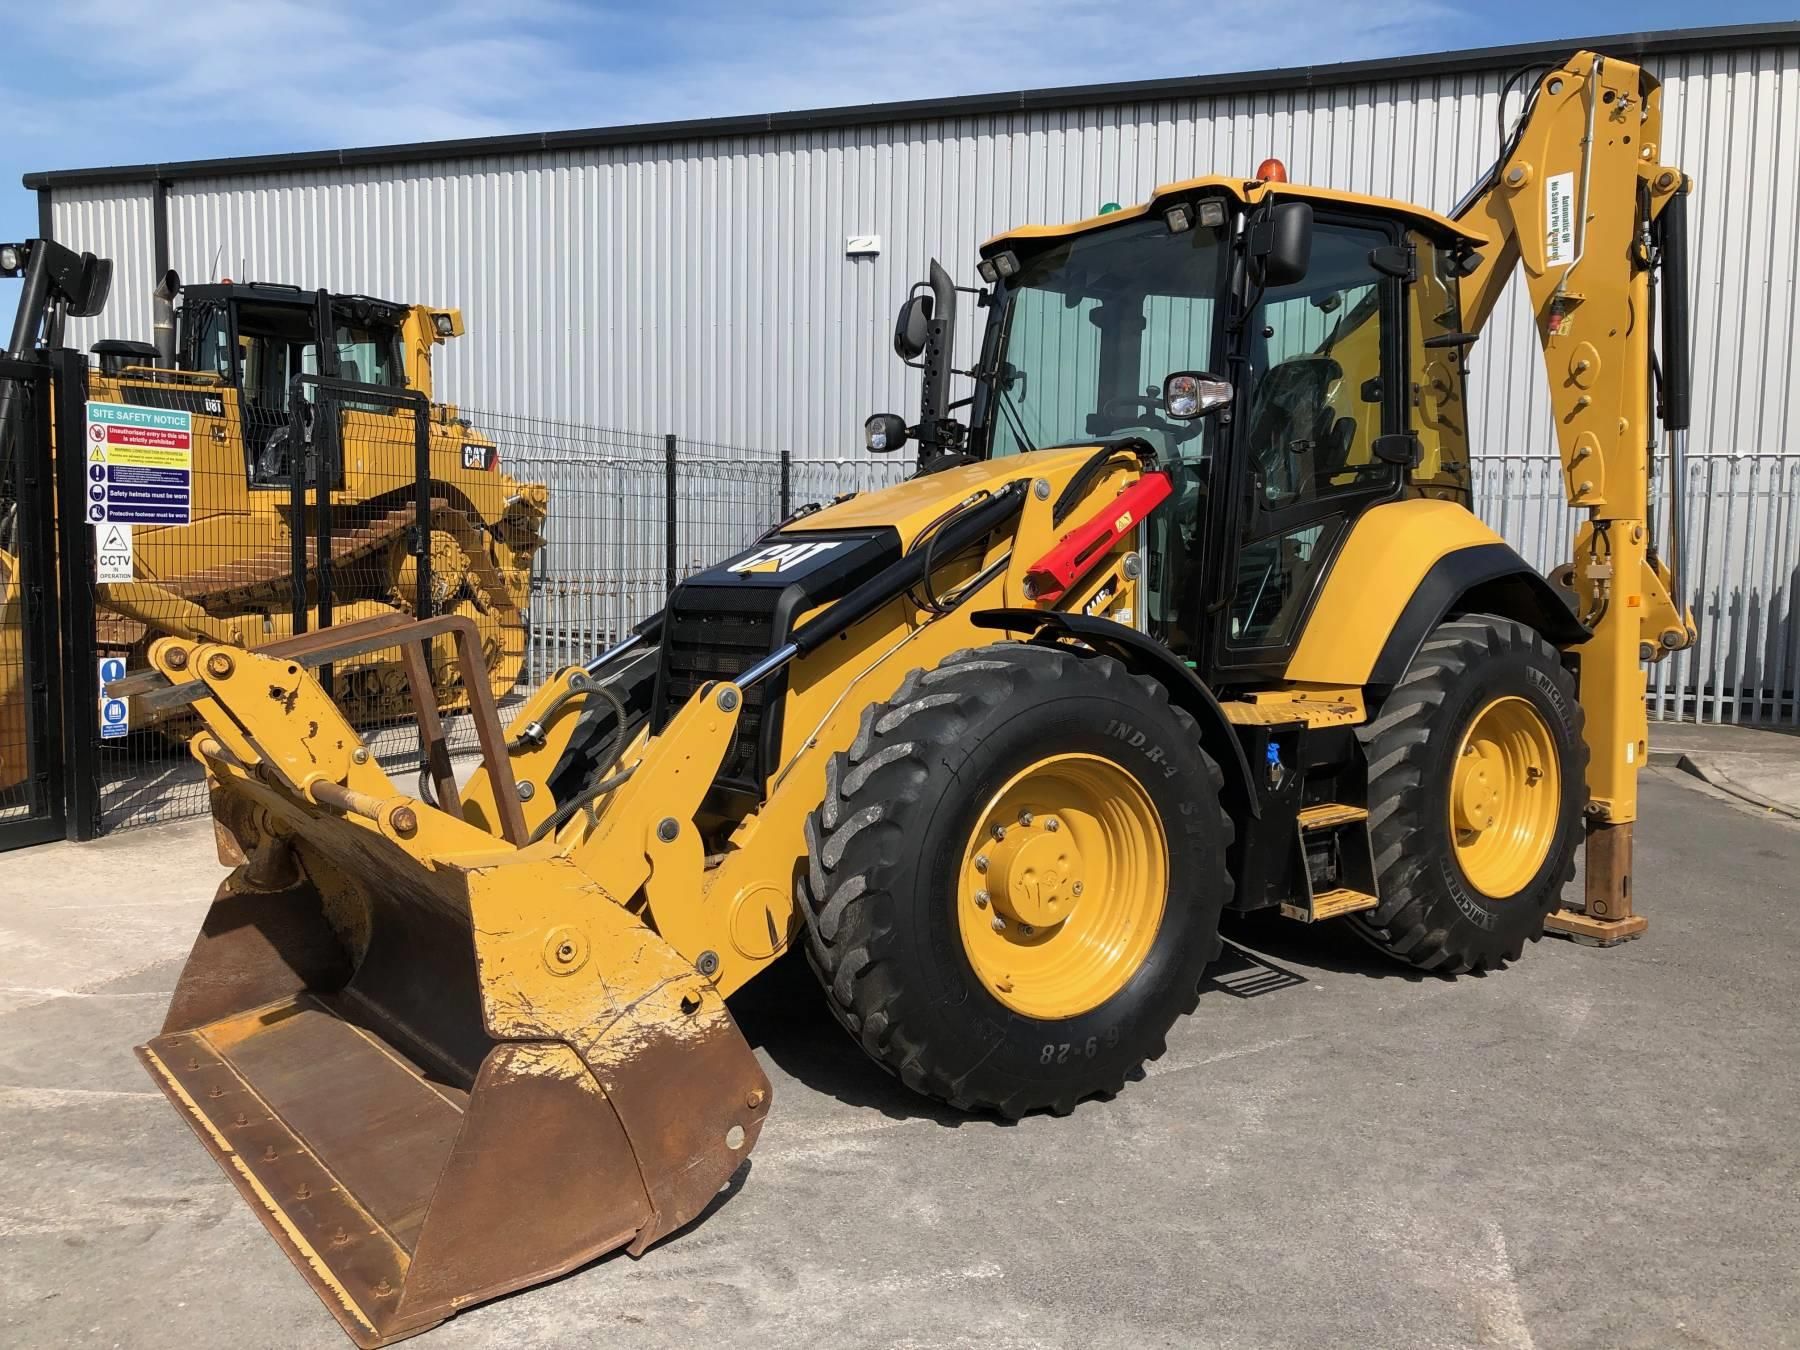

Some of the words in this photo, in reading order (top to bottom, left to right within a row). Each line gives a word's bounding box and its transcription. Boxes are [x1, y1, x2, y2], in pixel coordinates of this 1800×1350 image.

[1551, 181, 1559, 191] No
[1551, 191, 1559, 214] Safety
[1562, 195, 1570, 232] Automatic
[93, 408, 114, 419] SITE
[116, 411, 152, 422] SAFETY
[154, 414, 186, 426] NOTICE
[109, 428, 146, 436] Unauthorised
[146, 431, 160, 439] entry
[149, 438, 175, 446] prohibited
[464, 446, 487, 469] CAT
[109, 490, 128, 499] Safety
[129, 490, 151, 498] helmets
[100, 555, 130, 566] CCTV
[727, 542, 843, 573] CAT
